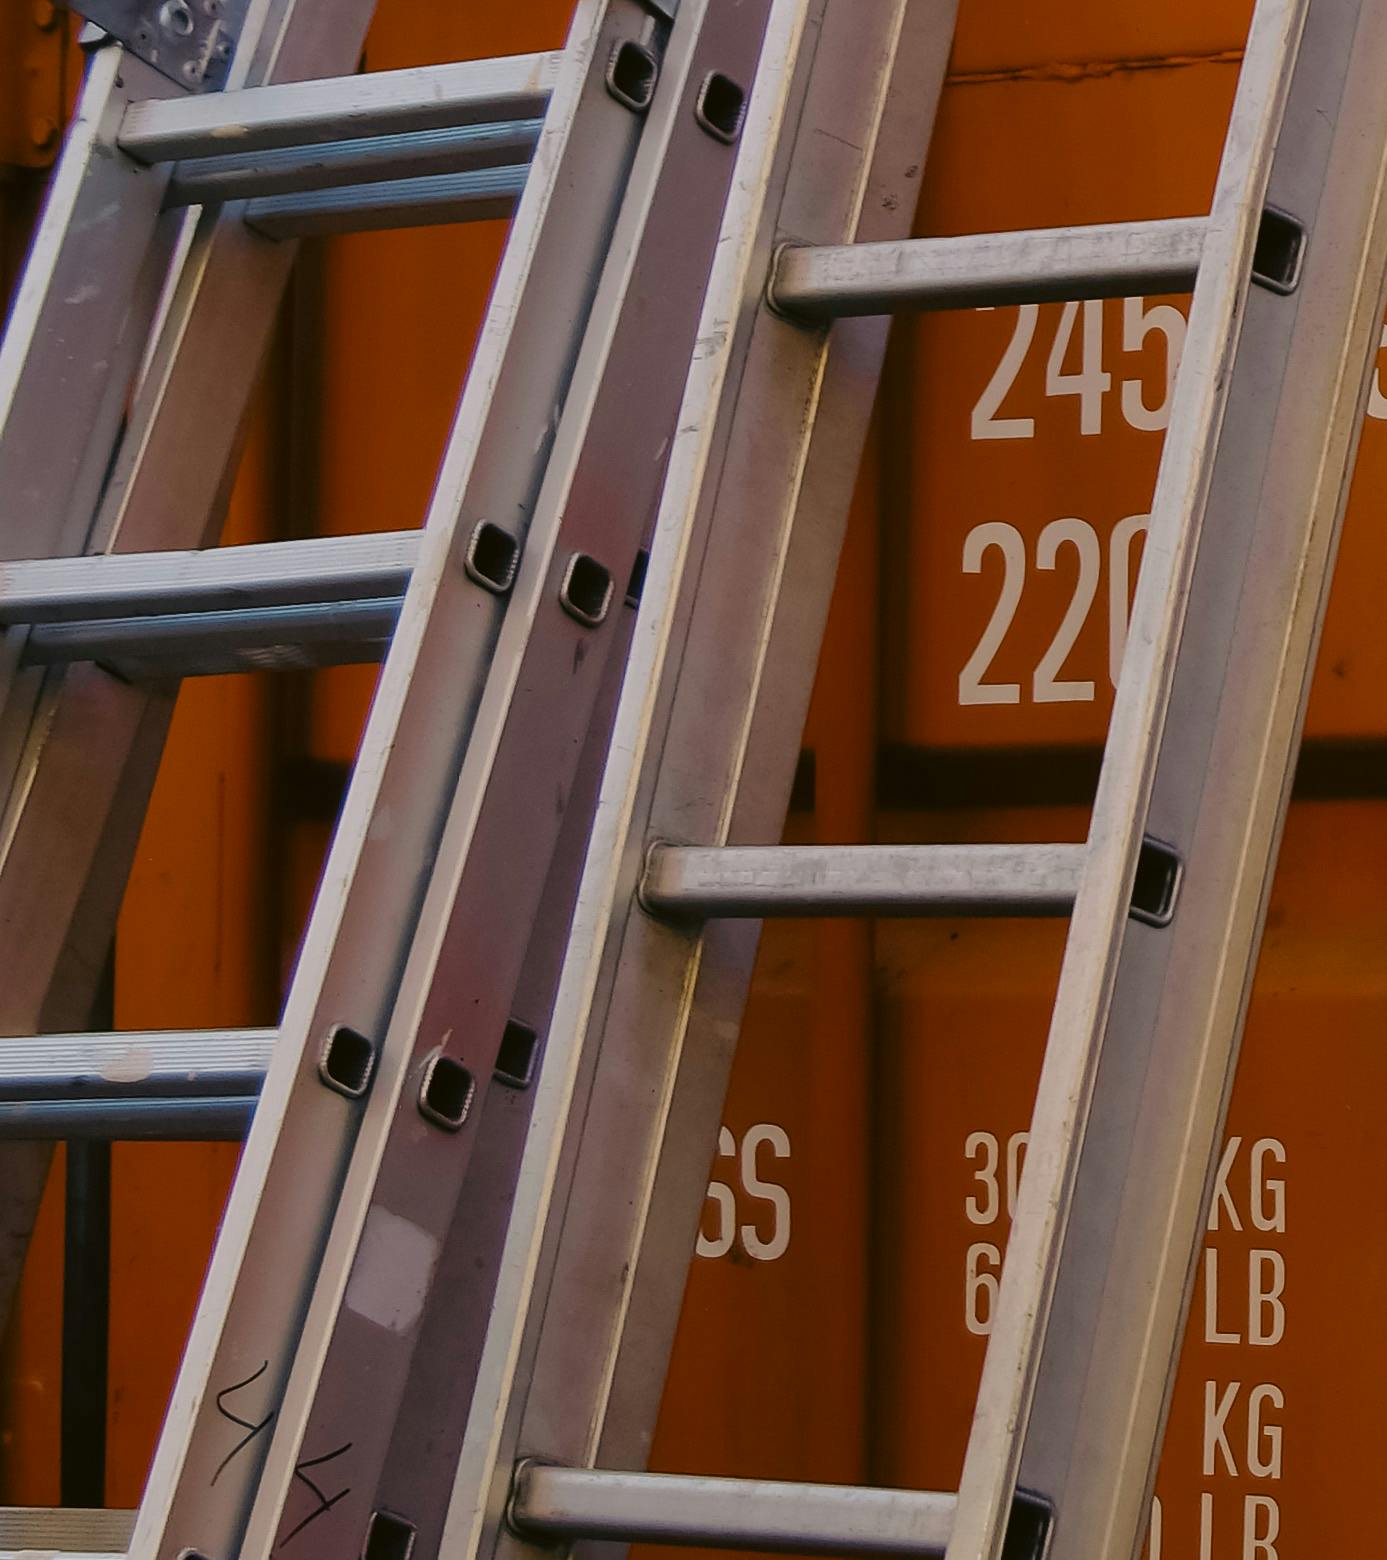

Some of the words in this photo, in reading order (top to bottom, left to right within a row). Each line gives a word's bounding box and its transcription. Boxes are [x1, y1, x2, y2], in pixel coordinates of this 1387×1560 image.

[1206, 1135, 1288, 1234] KG
[1203, 1247, 1287, 1346] LB
[1201, 1379, 1285, 1480] KG
